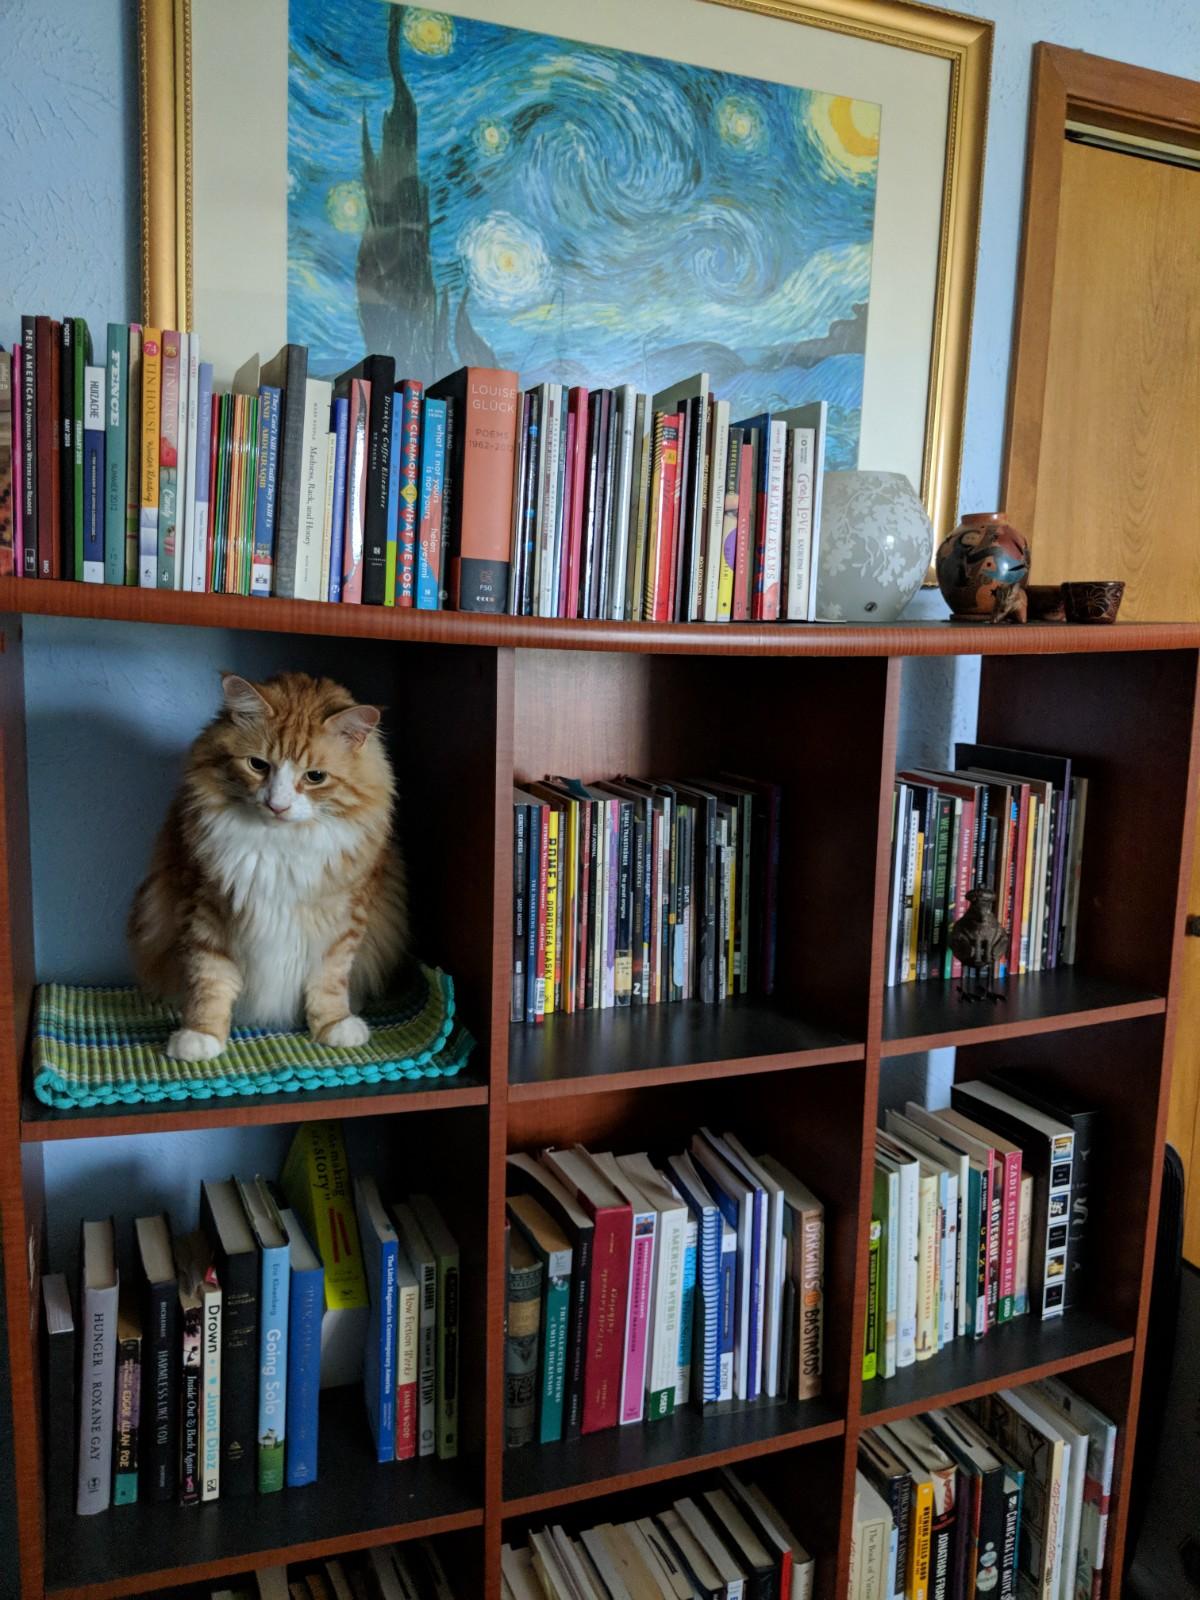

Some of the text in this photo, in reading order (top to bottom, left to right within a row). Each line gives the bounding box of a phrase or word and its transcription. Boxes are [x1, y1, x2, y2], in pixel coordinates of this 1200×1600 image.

[26, 354, 34, 400] AMERICA
[146, 362, 157, 385] TIN
[89, 380, 100, 419] HUIZACHE
[110, 349, 120, 427] FENCE
[166, 365, 176, 433] TIN HOUSE
[270, 393, 279, 410] They
[471, 383, 516, 399] LOUISE
[146, 389, 157, 434] HOUSE
[435, 424, 444, 448] what
[475, 428, 509, 439] POEMS
[307, 446, 318, 481] Madness,
[379, 395, 391, 509] Drinking Coffee Elsewhere
[434, 460, 442, 475] not
[266, 484, 275, 501] They
[306, 483, 316, 505] Rack,
[402, 390, 420, 597] ZINZI CLEMMONS WHAT WE LOSE
[425, 476, 433, 491] not
[431, 479, 441, 504] yours
[161, 488, 175, 518] Candy
[306, 505, 314, 520] and
[422, 495, 432, 519] yours
[766, 447, 783, 580] THE EMPATHY EXAMS
[303, 520, 314, 545] Honey
[429, 528, 439, 553] helen
[419, 540, 430, 578] oyeyemi
[935, 817, 950, 898] WE WILL BE SHELTER
[619, 898, 627, 919] enigma
[545, 900, 554, 946] DOROTHEA
[544, 951, 553, 980] LASKY
[989, 1198, 1001, 1263] GROTESQUE
[1004, 1163, 1018, 1296] ZADIE SMITH ON BEAU
[271, 1262, 281, 1276] Eric
[386, 1267, 394, 1285] Little
[665, 1228, 680, 1331] AMERICAN HYBRID
[385, 1286, 394, 1314] Magazine
[802, 1223, 822, 1376] DARWIN'S BASTARDS
[1003, 1298, 1011, 1317] USED
[559, 1306, 567, 1323] THE
[262, 1328, 281, 1376] Going
[383, 1323, 393, 1368] Contemporary
[556, 1325, 566, 1374] COLLECTED
[206, 1304, 221, 1432] Drown Junot
[402, 1293, 416, 1439] How Fiction Works JAMES WOOD
[546, 1323, 557, 1396] EMILY DICKINSON
[89, 1313, 105, 1461] HUNGER ROXANE GAY
[157, 1350, 169, 1400] HARMLESS
[186, 1375, 198, 1398] Inside
[422, 1368, 434, 1405] FICTION
[121, 1390, 133, 1417] EDGAR
[156, 1401, 169, 1421] LIKE
[186, 1400, 197, 1417] Out
[264, 1381, 281, 1415] Solo
[658, 1391, 669, 1414] USED
[120, 1420, 132, 1446] ALLAN
[156, 1424, 169, 1445] YOU
[185, 1428, 197, 1449] Back
[119, 1449, 130, 1467] POE
[183, 1450, 196, 1474] Again
[922, 1506, 931, 1537] NOTHING
[869, 1529, 878, 1543] The
[921, 1539, 930, 1560] FEELS
[867, 1544, 876, 1564] Book
[936, 1532, 949, 1578] JONATHAN
[1001, 1511, 1018, 1594] CHANG-RAE LEE NATIVE
[919, 1561, 928, 1581] GOOD
